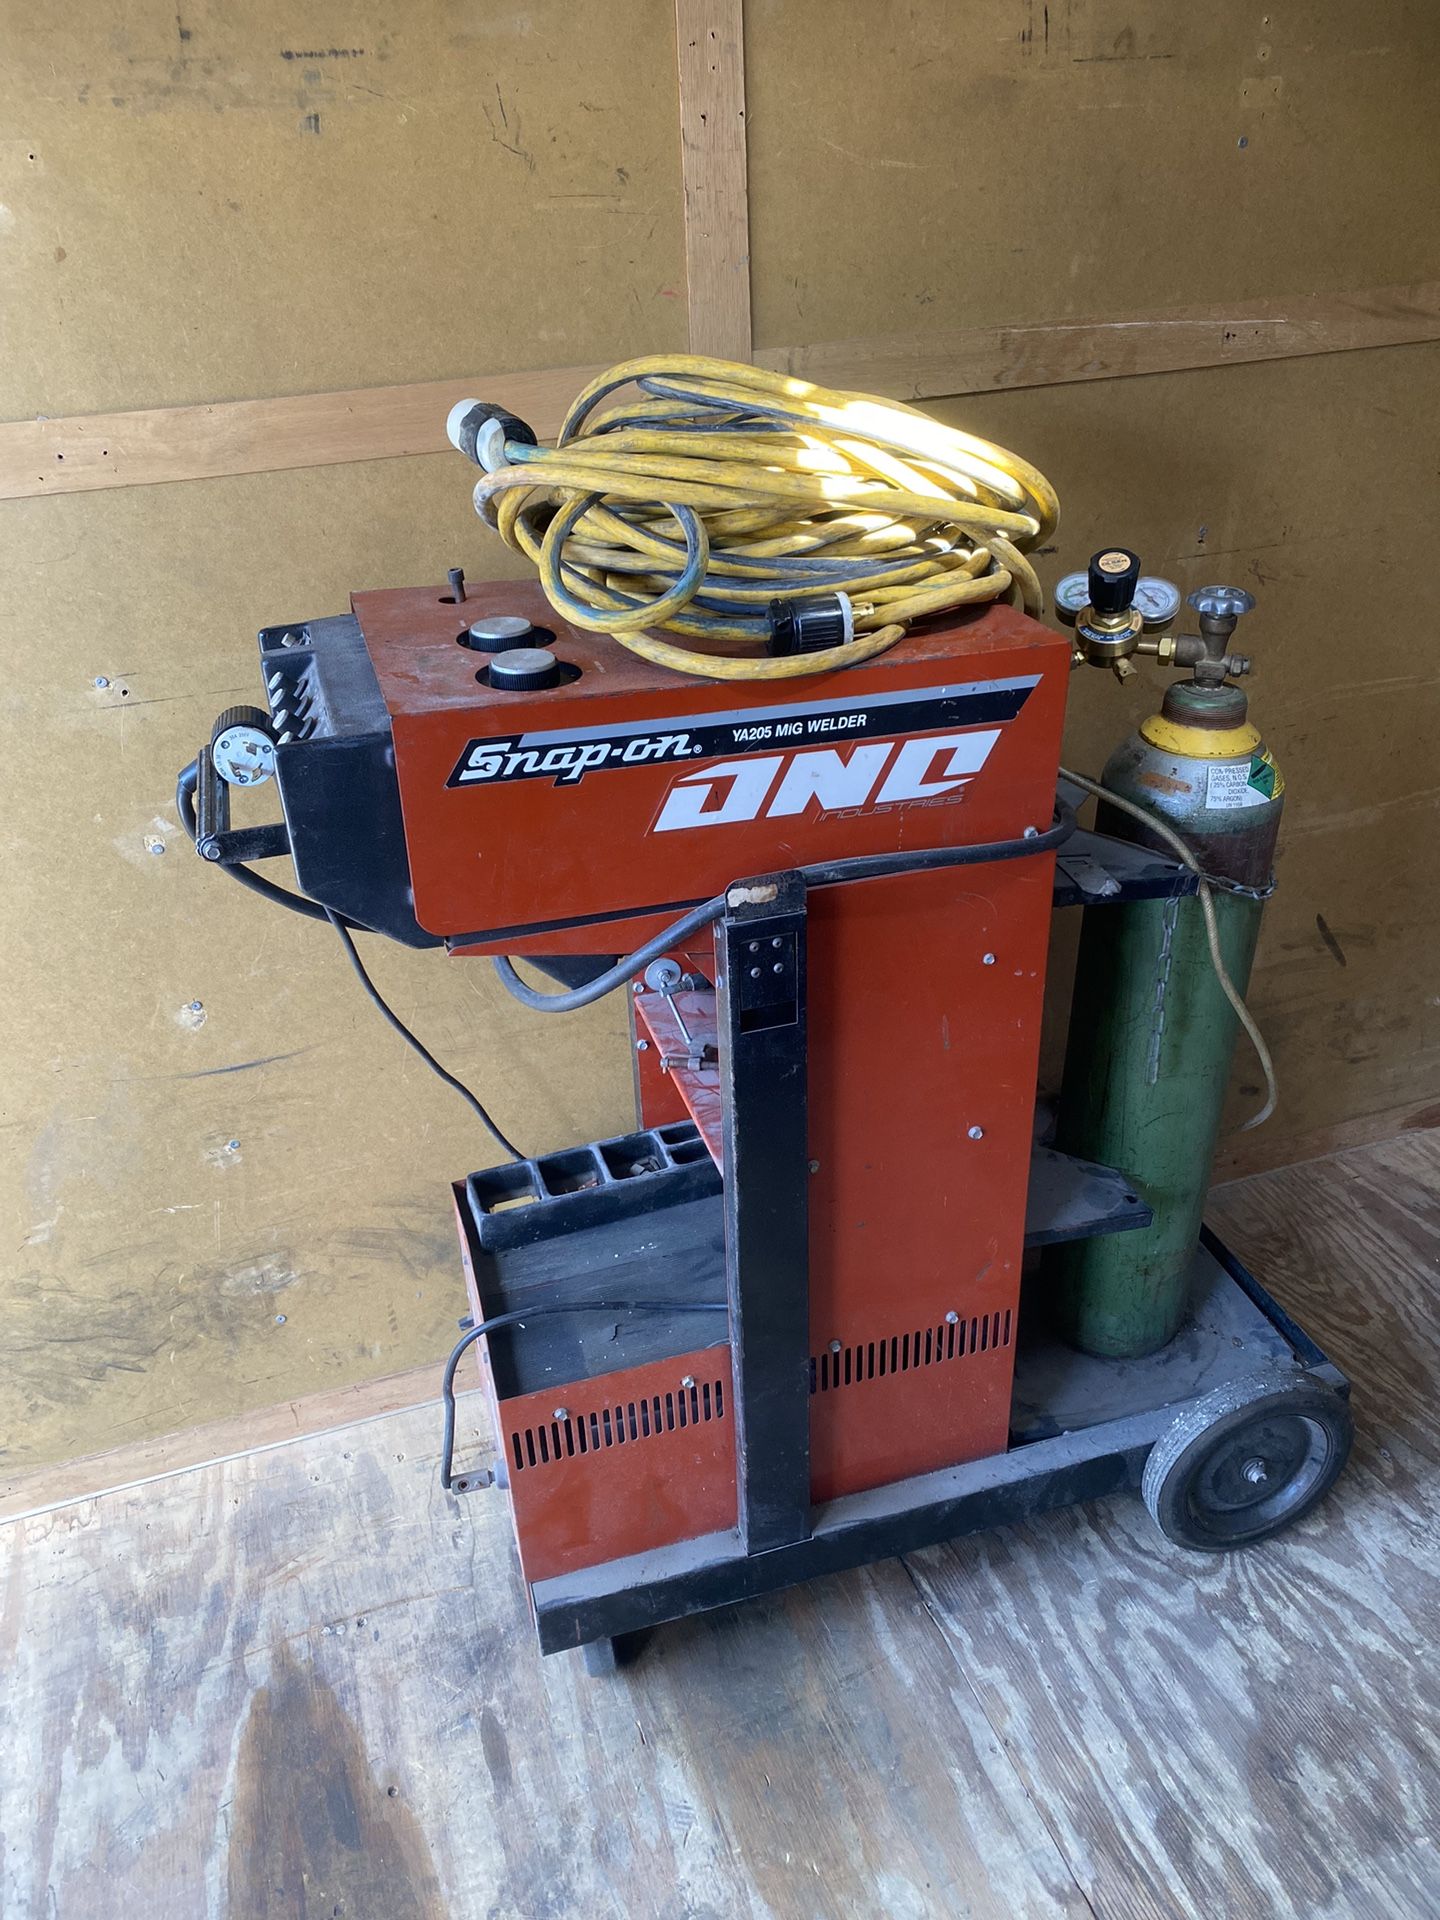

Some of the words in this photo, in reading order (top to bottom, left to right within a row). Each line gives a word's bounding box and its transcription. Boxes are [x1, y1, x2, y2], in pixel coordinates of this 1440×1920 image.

[732, 726, 772, 742] YA205
[775, 722, 803, 737] MIG
[807, 714, 867, 733] WELDER
[458, 733, 693, 781] Snap-on
[817, 793, 964, 823] INDUSTRIES
